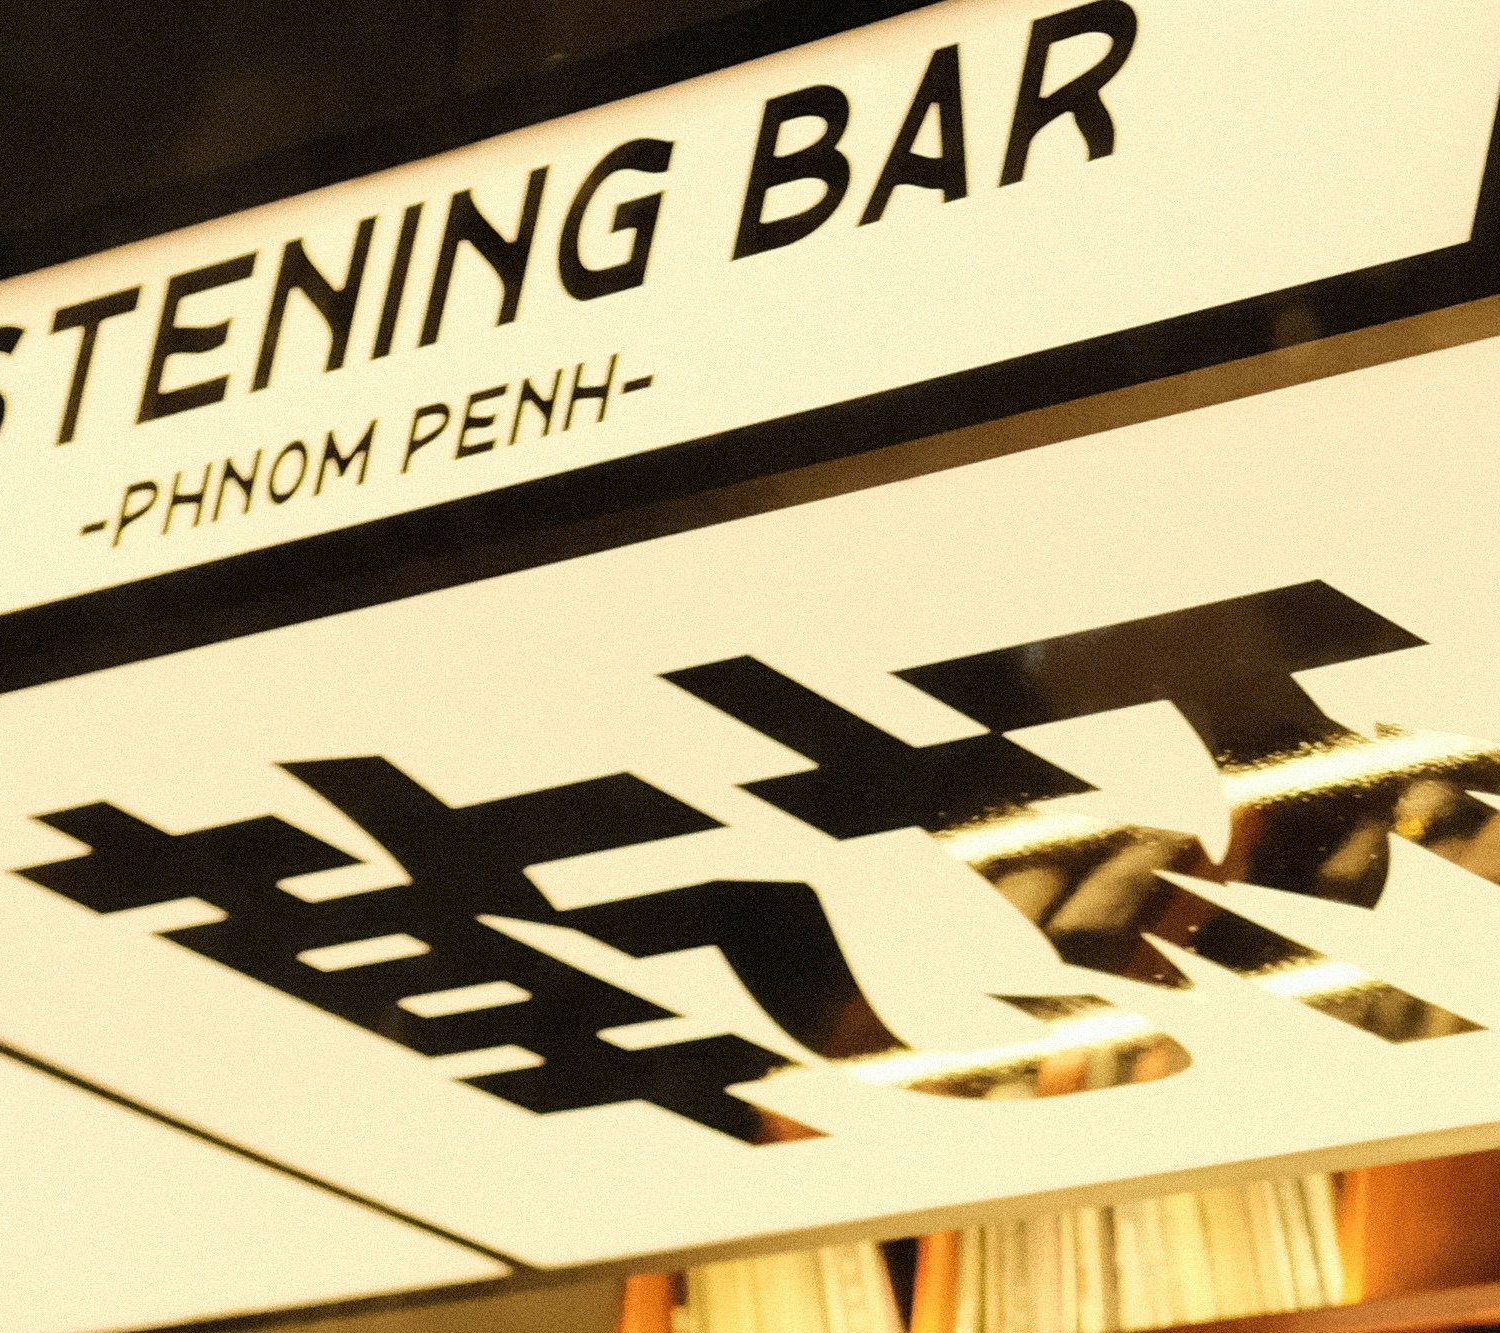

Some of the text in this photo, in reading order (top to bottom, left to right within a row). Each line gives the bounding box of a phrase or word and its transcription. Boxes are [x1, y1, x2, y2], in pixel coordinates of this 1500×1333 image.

[731, 0, 1138, 261] BAR
[79, 364, 656, 550] -PHNOM PENH-
